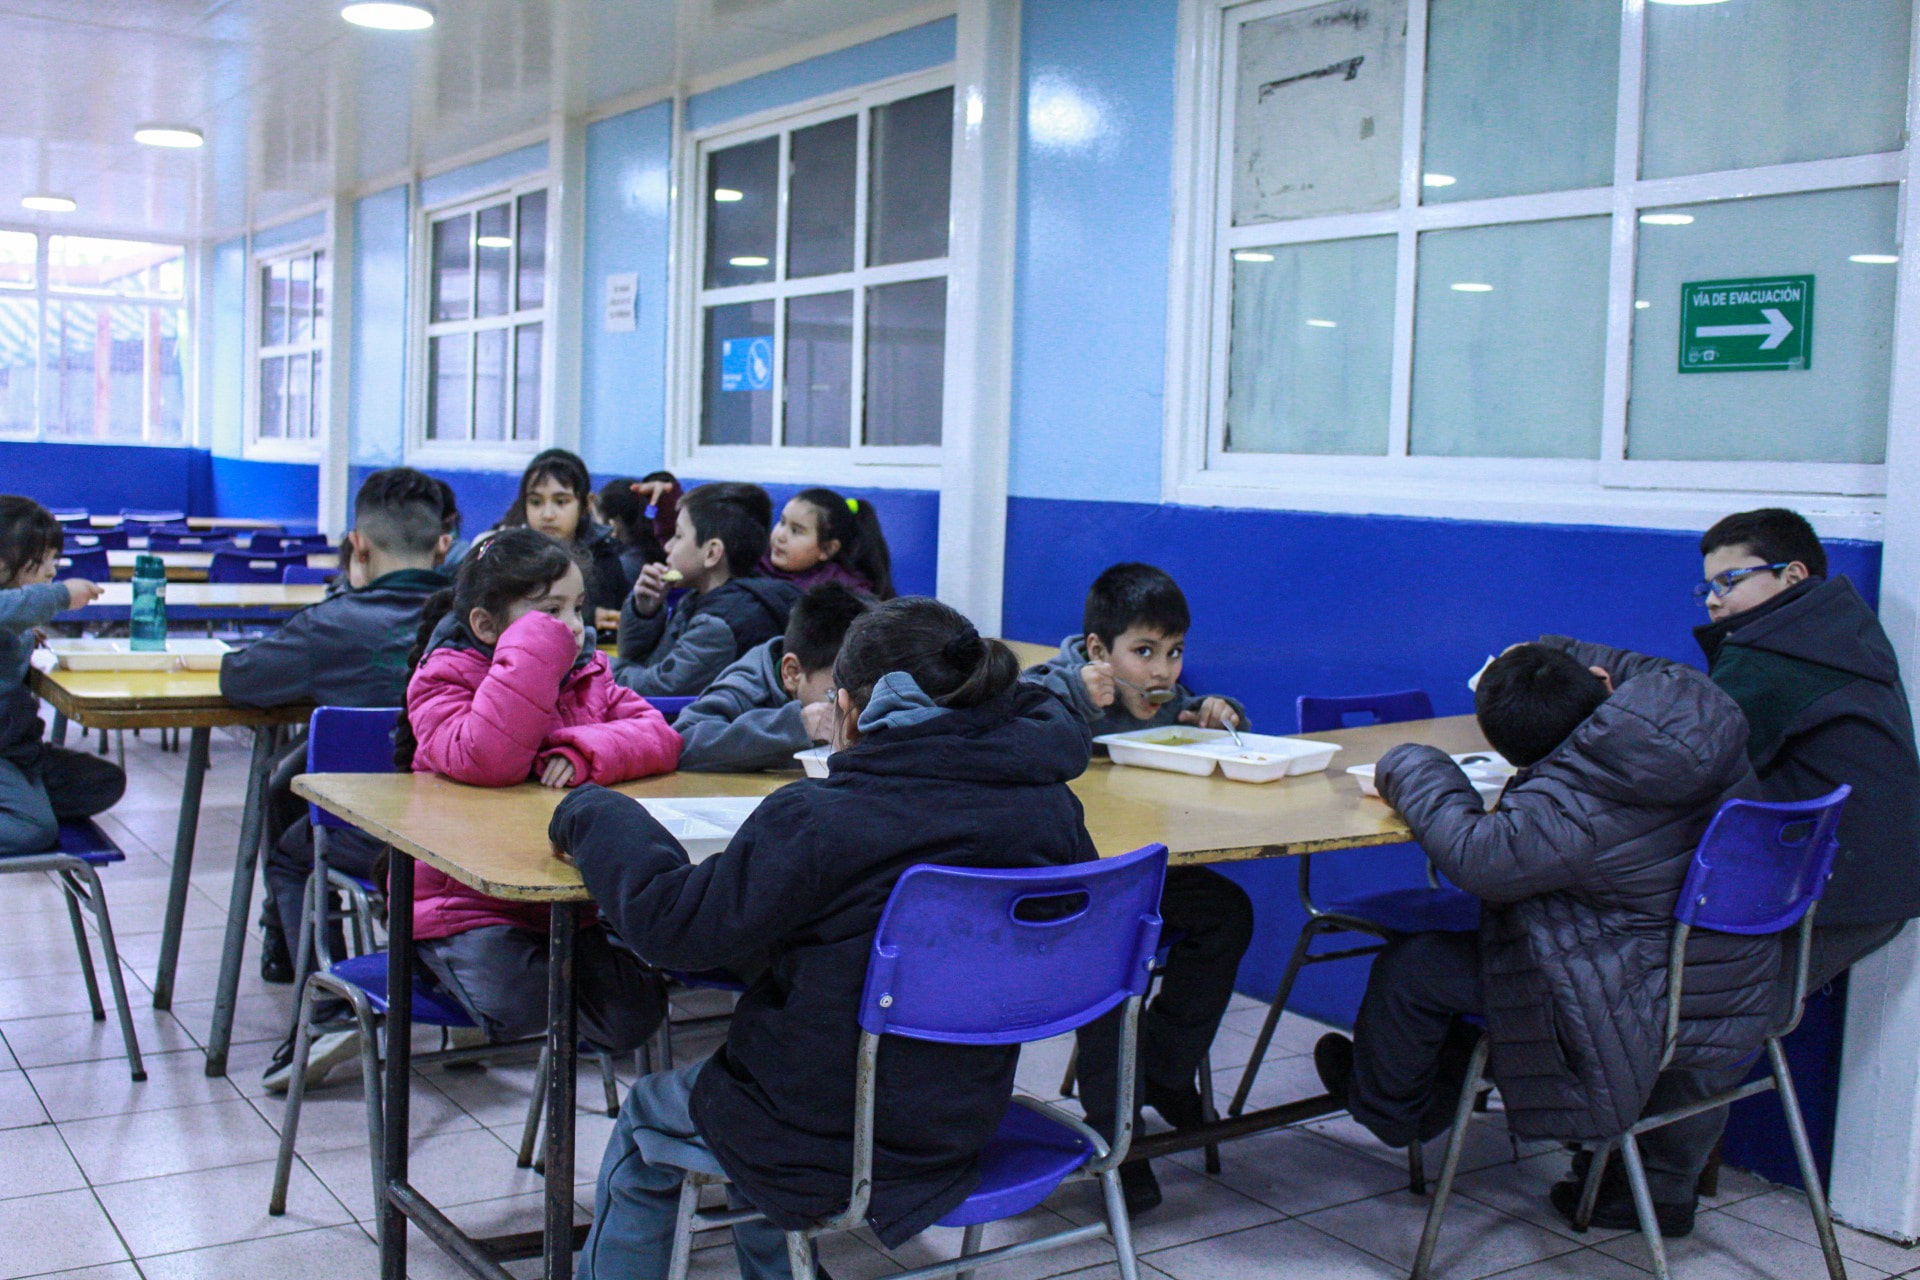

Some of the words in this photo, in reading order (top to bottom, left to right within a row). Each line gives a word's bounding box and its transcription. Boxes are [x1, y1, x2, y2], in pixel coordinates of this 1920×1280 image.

[1692, 291, 1710, 307] VÍA
[1712, 292, 1727, 306] DE
[1729, 286, 1801, 305] EVACUACIÓN
